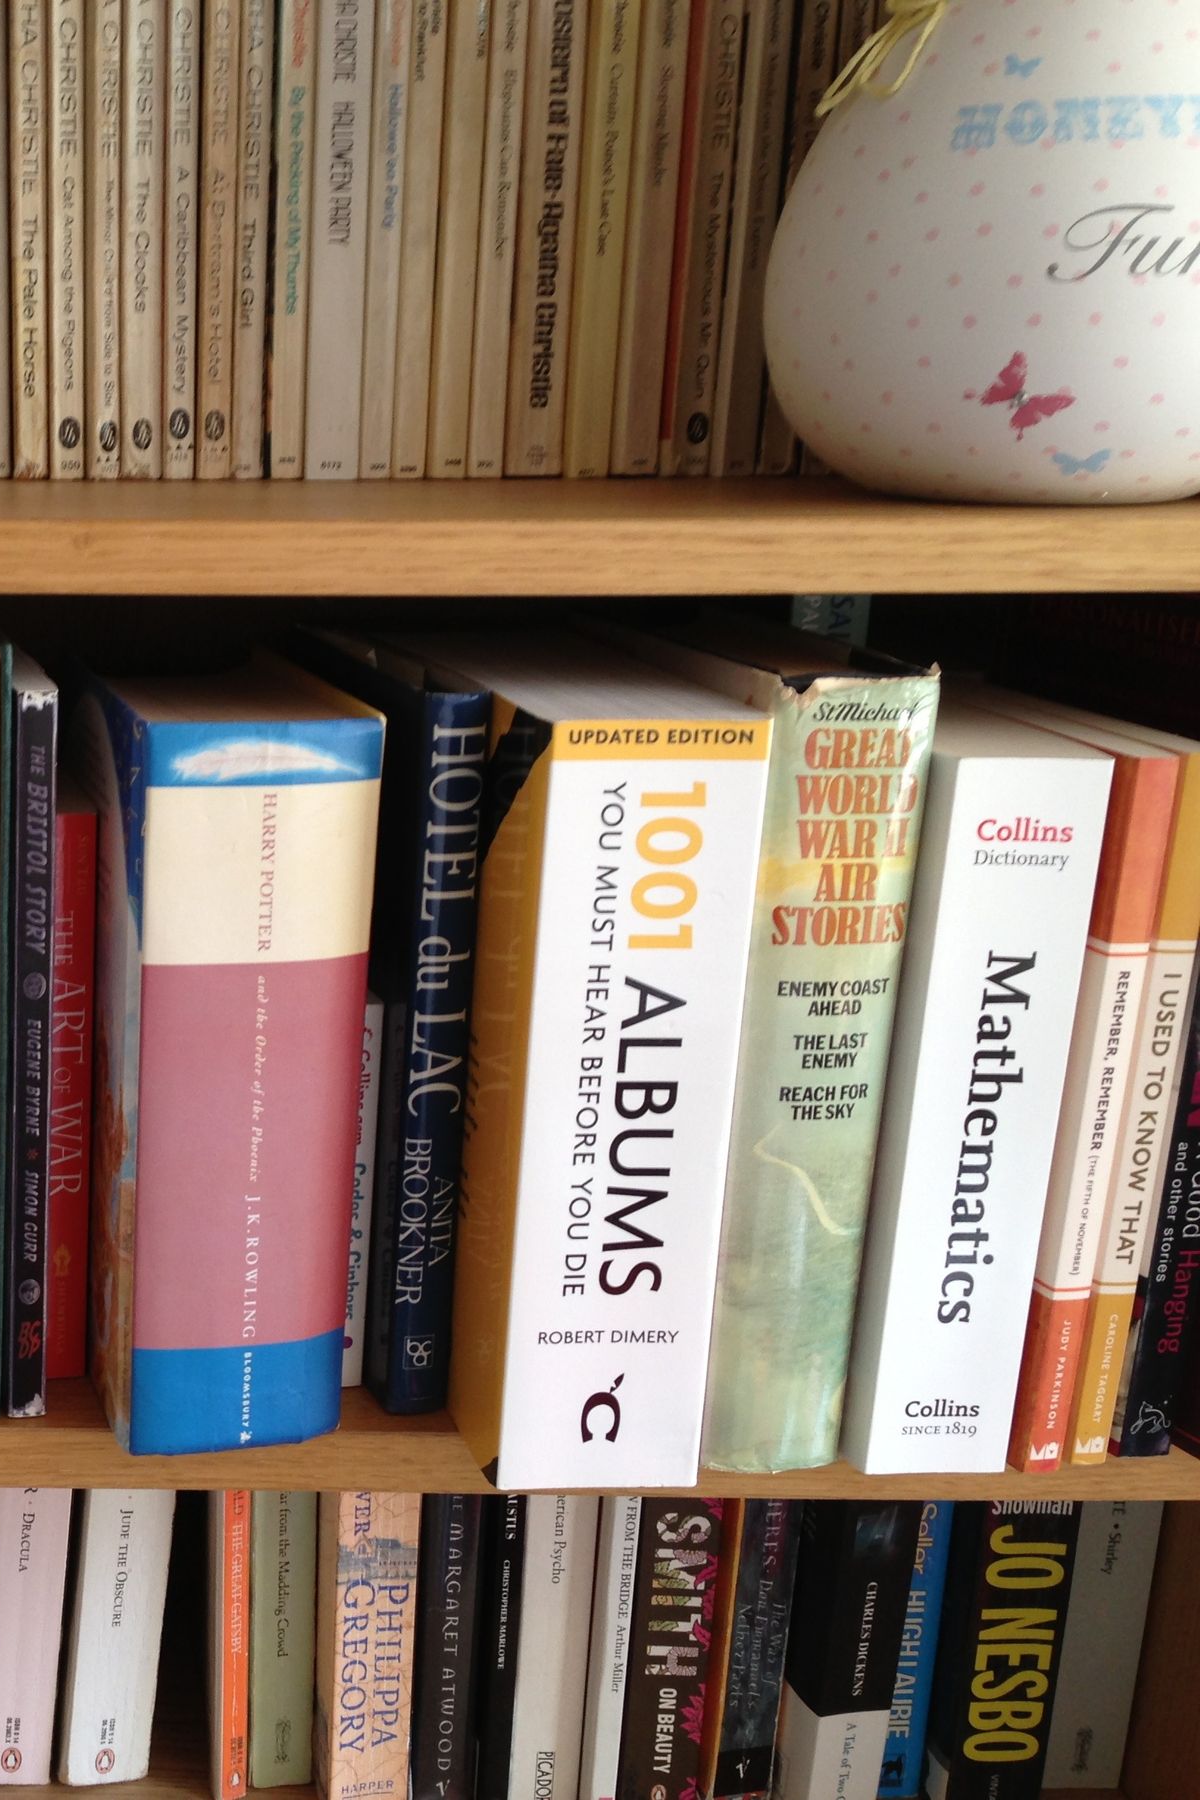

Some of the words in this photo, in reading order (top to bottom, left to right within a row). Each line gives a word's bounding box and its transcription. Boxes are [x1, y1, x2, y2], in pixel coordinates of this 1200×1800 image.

[329, 102, 354, 192] HALLOWEEN
[950, 94, 1200, 151] HONEY
[22, 214, 38, 260] The
[327, 198, 352, 245] PARTY
[22, 269, 38, 319] Pale
[22, 327, 38, 398] Horse
[568, 729, 658, 747] UPDATED
[666, 727, 756, 746] EDITION
[258, 792, 279, 864] HARRY
[418, 723, 488, 922] HOTEL
[597, 782, 629, 852] YOU
[797, 819, 878, 860] WAR
[976, 818, 1074, 844] Collins
[627, 780, 708, 950] 1001
[813, 861, 879, 902] AIR
[972, 850, 1070, 868] Dictionary
[257, 870, 277, 953] POTTER
[588, 865, 621, 953] MUST
[771, 902, 907, 947] STORIES
[416, 935, 455, 992] du
[776, 981, 834, 997] ENEMY
[839, 977, 891, 995] COAST
[1162, 972, 1183, 981] I
[581, 964, 613, 1045] HEAR
[807, 1001, 863, 1016] AHEAD
[1146, 990, 1180, 1057] USED
[24, 1018, 43, 1078] EUGENE
[407, 1009, 467, 1119] LAC
[24, 1085, 42, 1136] BYRNE
[571, 1057, 604, 1167] BEFORE
[779, 1085, 834, 1101] REACH
[839, 1083, 870, 1099] FOR
[1142, 1068, 1169, 1101] TO
[598, 975, 688, 1297] ALBUMS
[935, 949, 1038, 1327] Mathematics
[1127, 1110, 1163, 1193] KNOW
[21, 1170, 40, 1216] SIMON
[392, 1136, 432, 1305] BROOKNER
[426, 1175, 455, 1267] ANITA
[564, 1177, 596, 1242] YOU
[19, 1221, 39, 1264] GURR
[1114, 1202, 1146, 1266] THAT
[241, 1195, 262, 1340] J.K.ROWLING
[562, 1253, 589, 1298] DIE
[537, 1330, 604, 1347] ROBERT
[610, 1329, 681, 1346] DIMERY
[1097, 1314, 1121, 1369] CAROLINE
[240, 1351, 253, 1428] BLOOMSBURY
[903, 1400, 981, 1418] Collins
[1090, 1372, 1112, 1424] TAGGART
[900, 1425, 942, 1438] SINCE
[946, 1423, 978, 1440] 1819
[18, 1512, 36, 1573] DRACULA
[119, 1509, 135, 1540] JUDE
[117, 1544, 129, 1567] THE
[550, 1540, 567, 1584] Psycho
[985, 1525, 1068, 1590] JO
[1100, 1532, 1121, 1575] Shirley
[111, 1571, 128, 1628] OBSCURE
[443, 1523, 465, 1657] MARGARET
[499, 1559, 511, 1623] CHRISTOPHER
[645, 1512, 712, 1677] SMITH
[859, 1581, 879, 1639] CHARLES
[339, 1579, 375, 1753] GREGORY
[371, 1581, 409, 1748] PHILIPPA
[497, 1625, 507, 1670] MARLOWE
[851, 1642, 869, 1697] DICKENS
[658, 1688, 677, 1710] ON
[963, 1608, 1058, 1762] NESBO
[437, 1667, 456, 1771] ATWOOD
[652, 1714, 676, 1774] BEAUTY
[340, 1780, 395, 1794] HARPER
